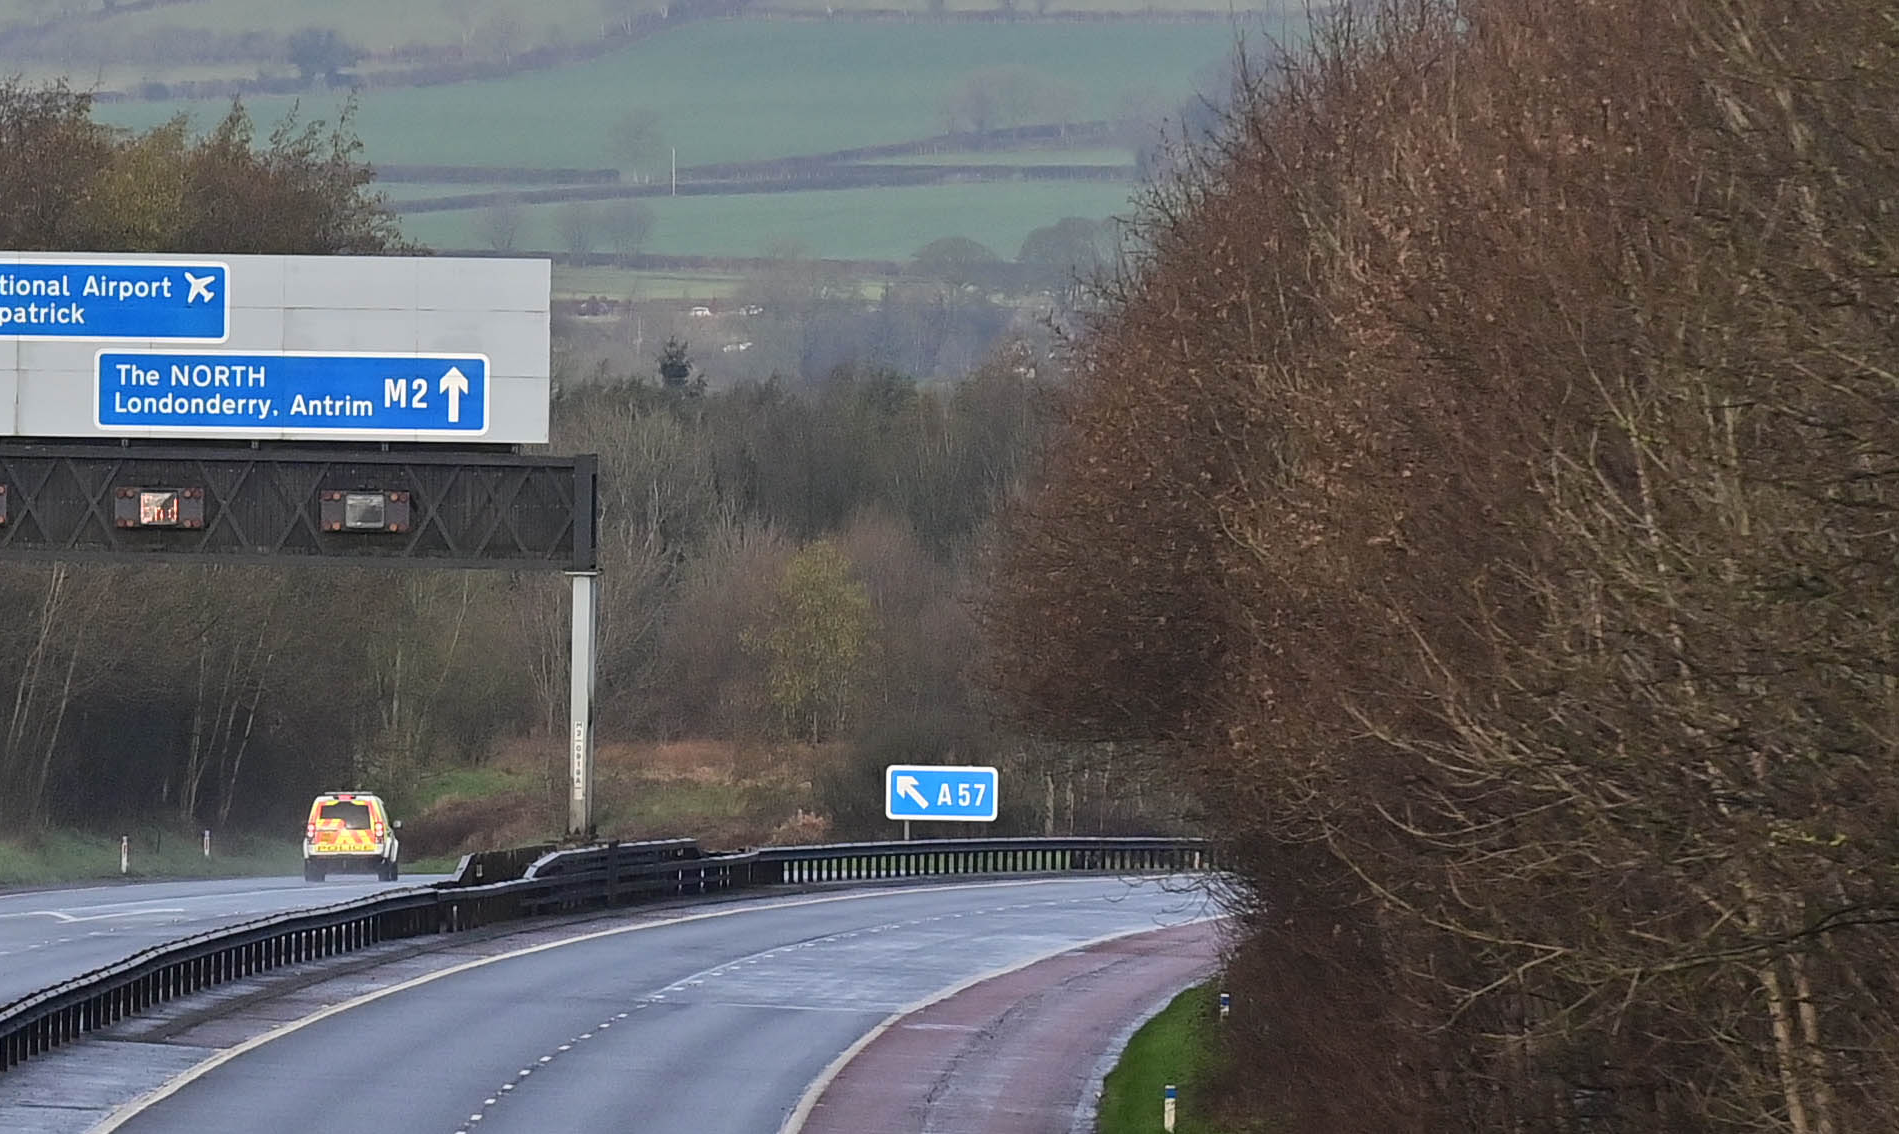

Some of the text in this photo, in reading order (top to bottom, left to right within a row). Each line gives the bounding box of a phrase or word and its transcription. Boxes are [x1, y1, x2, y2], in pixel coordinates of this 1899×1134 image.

[82, 275, 172, 301] Airport
[115, 364, 266, 388] The NORTH
[289, 394, 373, 417] Antrim
[384, 378, 428, 409] M2
[937, 783, 986, 807] A57
